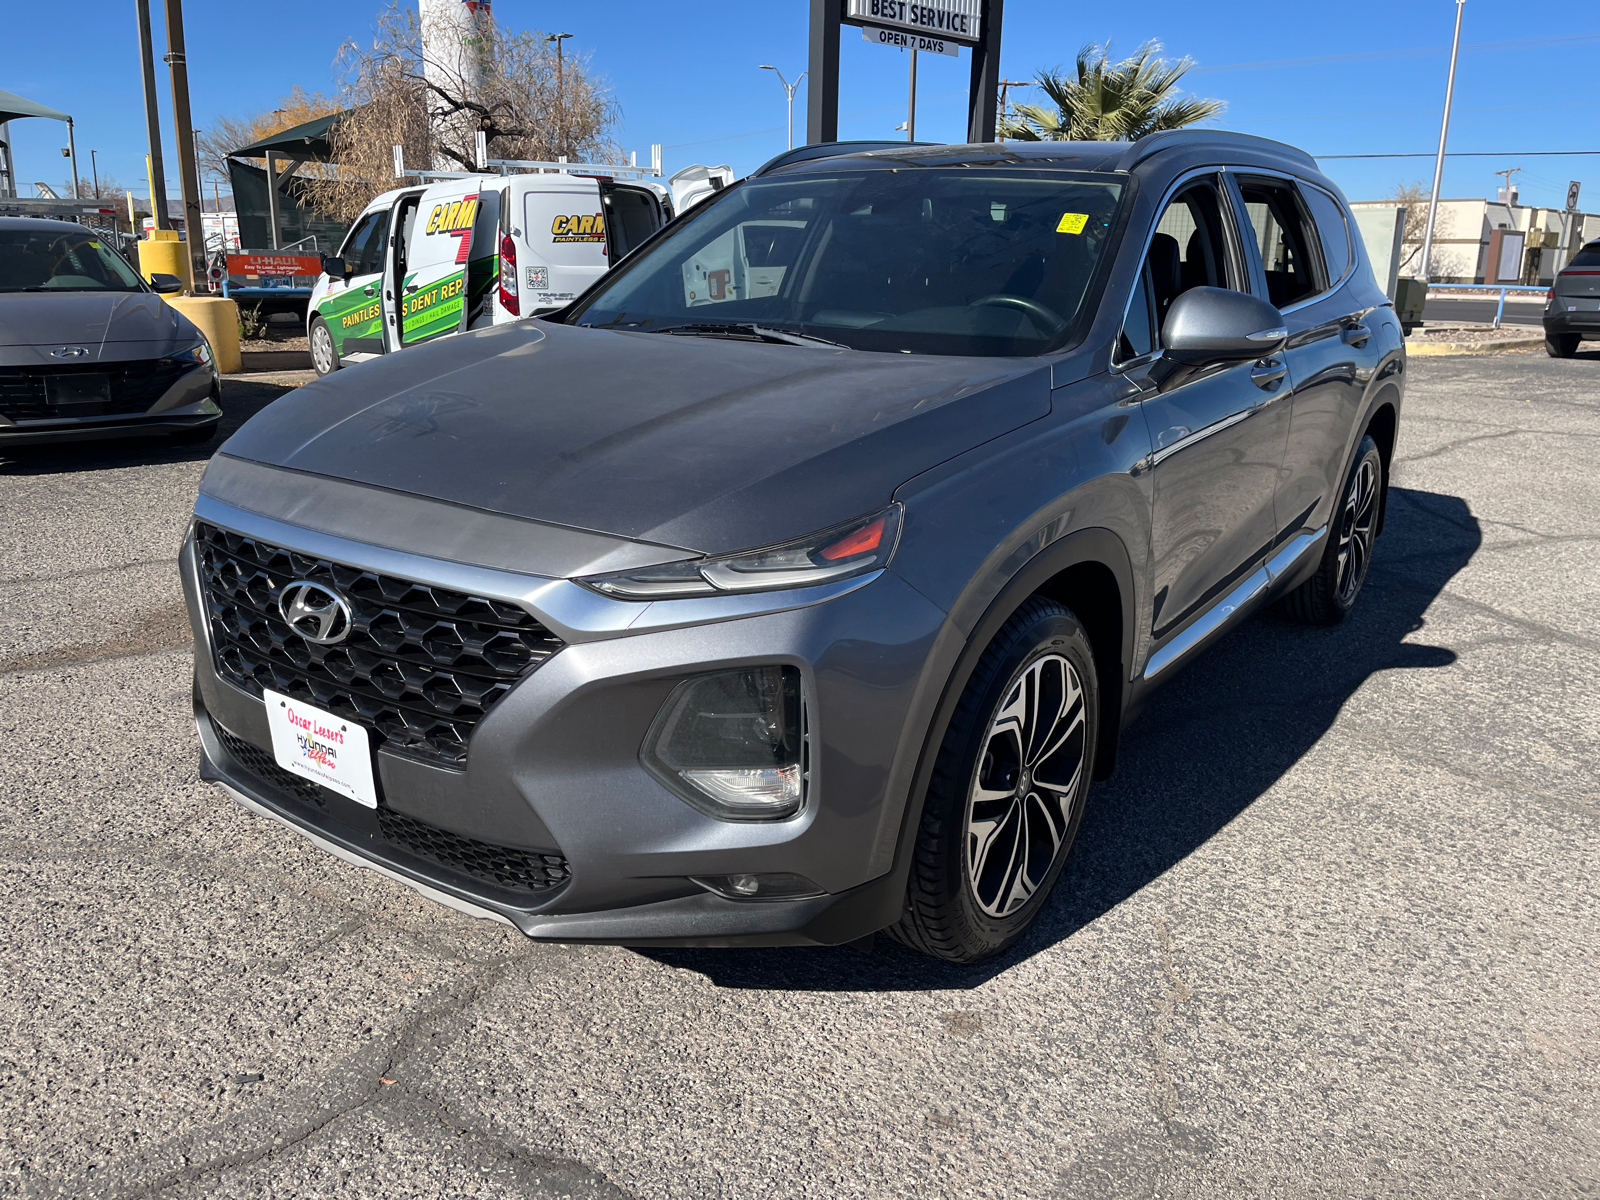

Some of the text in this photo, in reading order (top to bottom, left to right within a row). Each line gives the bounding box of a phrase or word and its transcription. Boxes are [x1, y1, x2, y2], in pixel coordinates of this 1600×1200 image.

[871, 0, 968, 33] BEST SERVICE
[879, 31, 944, 52] OPEN 7 DAYS
[250, 256, 299, 265] U-HAUL
[411, 289, 438, 313] DENT
[441, 300, 460, 315] DAMAGE
[288, 708, 344, 744] Oscar Leeser's
[297, 733, 337, 759] HYUNDAI
